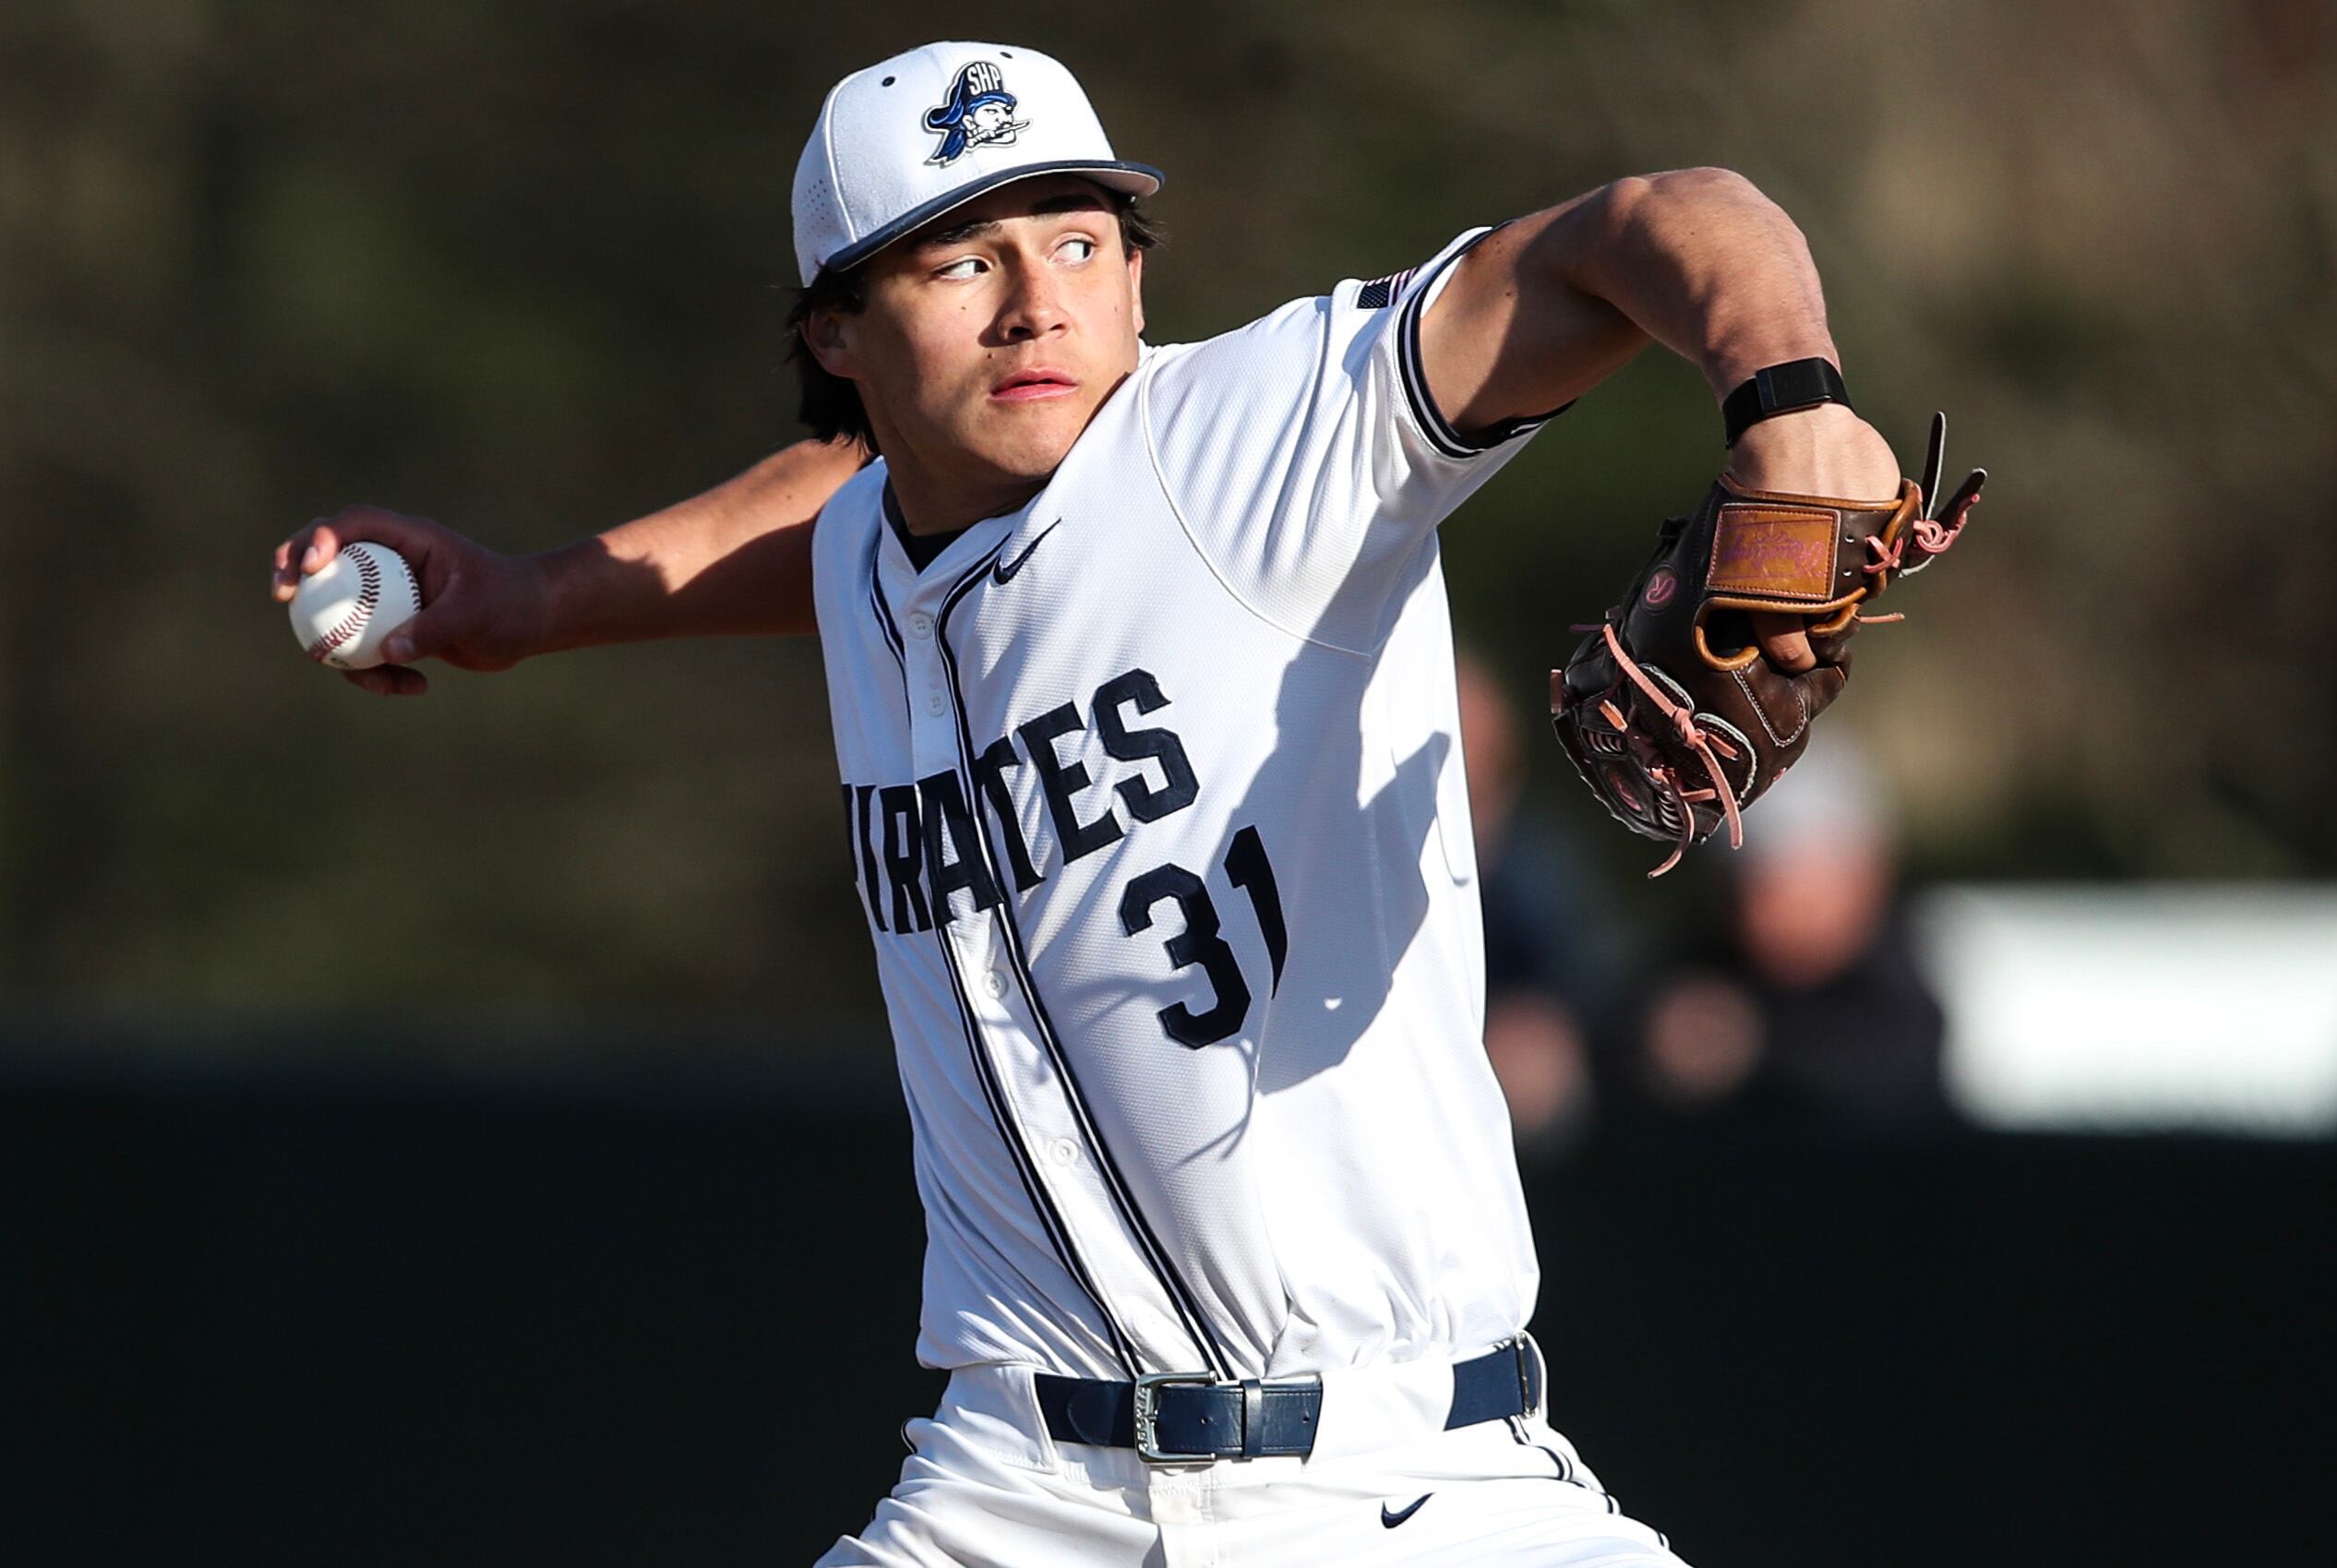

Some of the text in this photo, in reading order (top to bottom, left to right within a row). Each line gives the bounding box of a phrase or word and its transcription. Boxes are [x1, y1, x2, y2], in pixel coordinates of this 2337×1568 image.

[966, 61, 1001, 95] SHP
[1646, 574, 1676, 604] R
[1119, 824, 1288, 1050] 31
